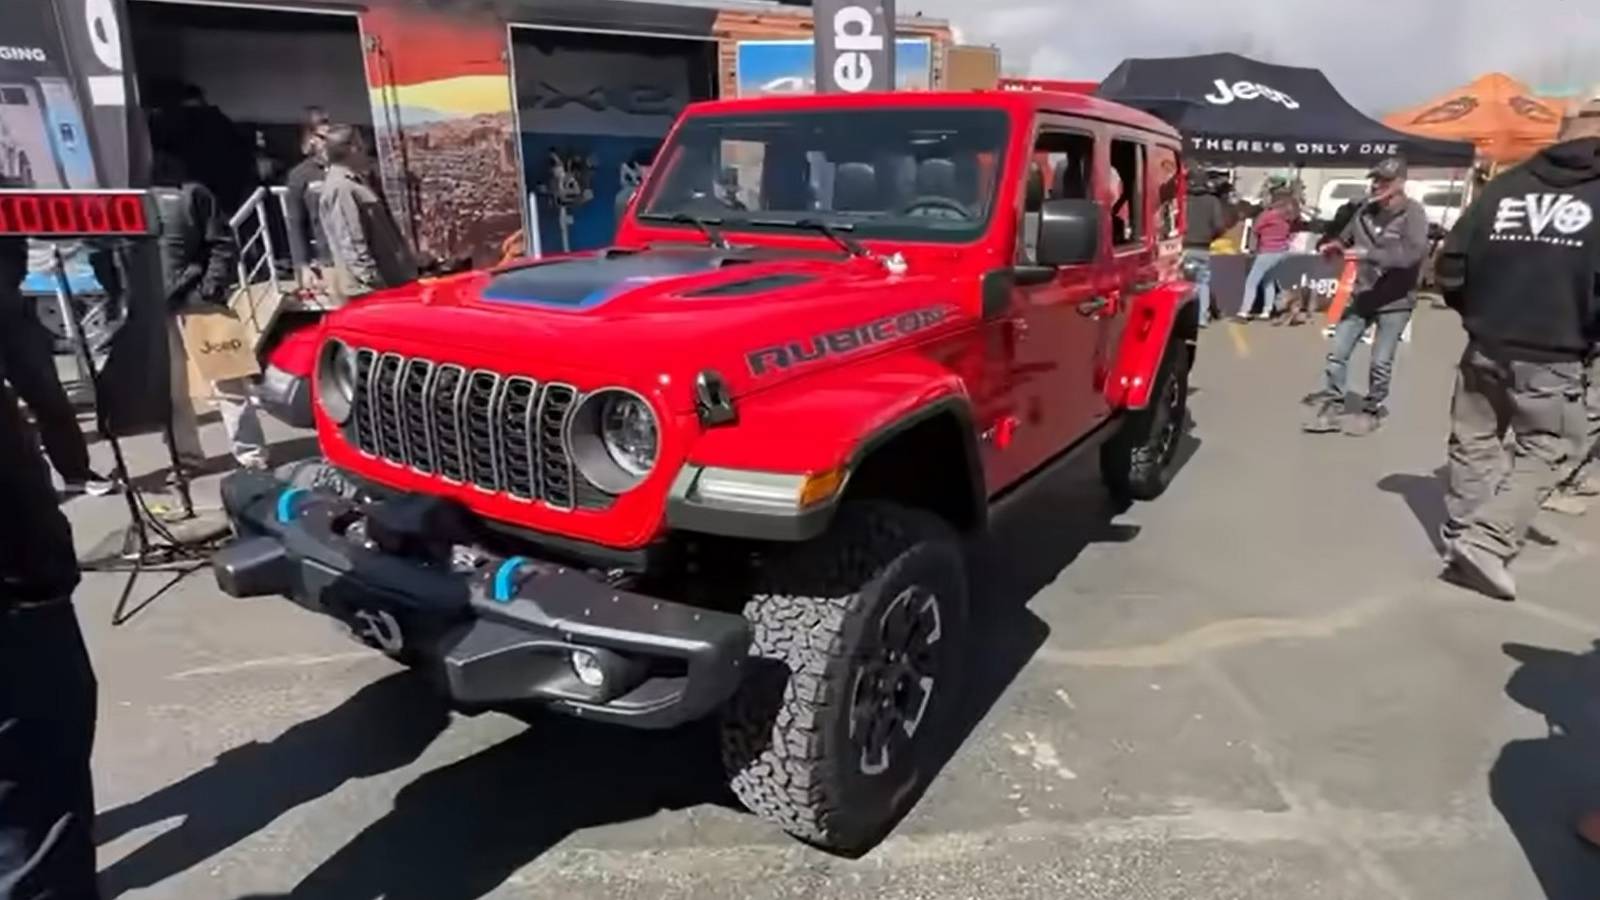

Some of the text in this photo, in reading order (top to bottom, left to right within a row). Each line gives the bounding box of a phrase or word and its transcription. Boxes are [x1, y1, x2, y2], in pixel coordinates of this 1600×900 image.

[1204, 78, 1299, 109] Jeep
[1191, 138, 1398, 155] THERE'S ONLY ONE
[745, 304, 949, 378] RUBICON
